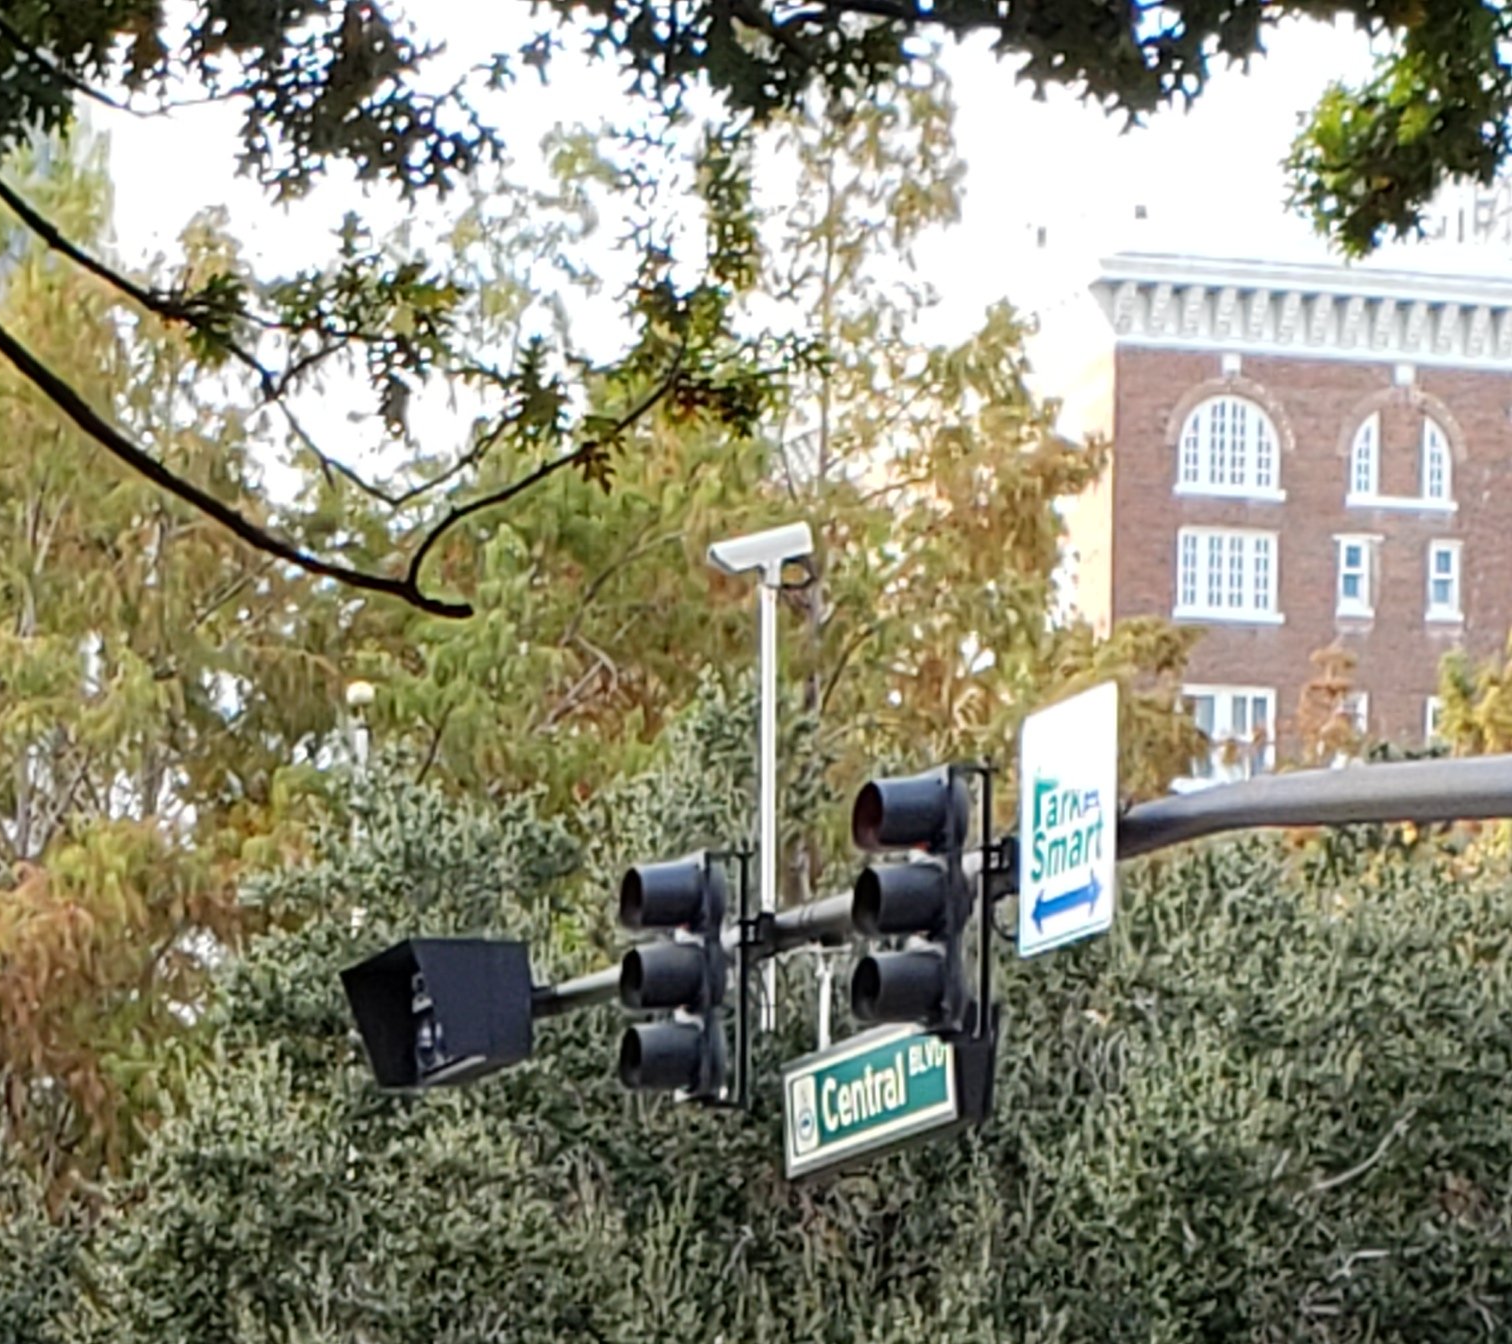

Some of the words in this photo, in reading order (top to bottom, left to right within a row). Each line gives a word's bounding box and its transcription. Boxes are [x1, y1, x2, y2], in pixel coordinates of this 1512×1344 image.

[1031, 807, 1104, 883] Smart
[822, 1051, 907, 1132] Central
[908, 1037, 945, 1077] BLVD
